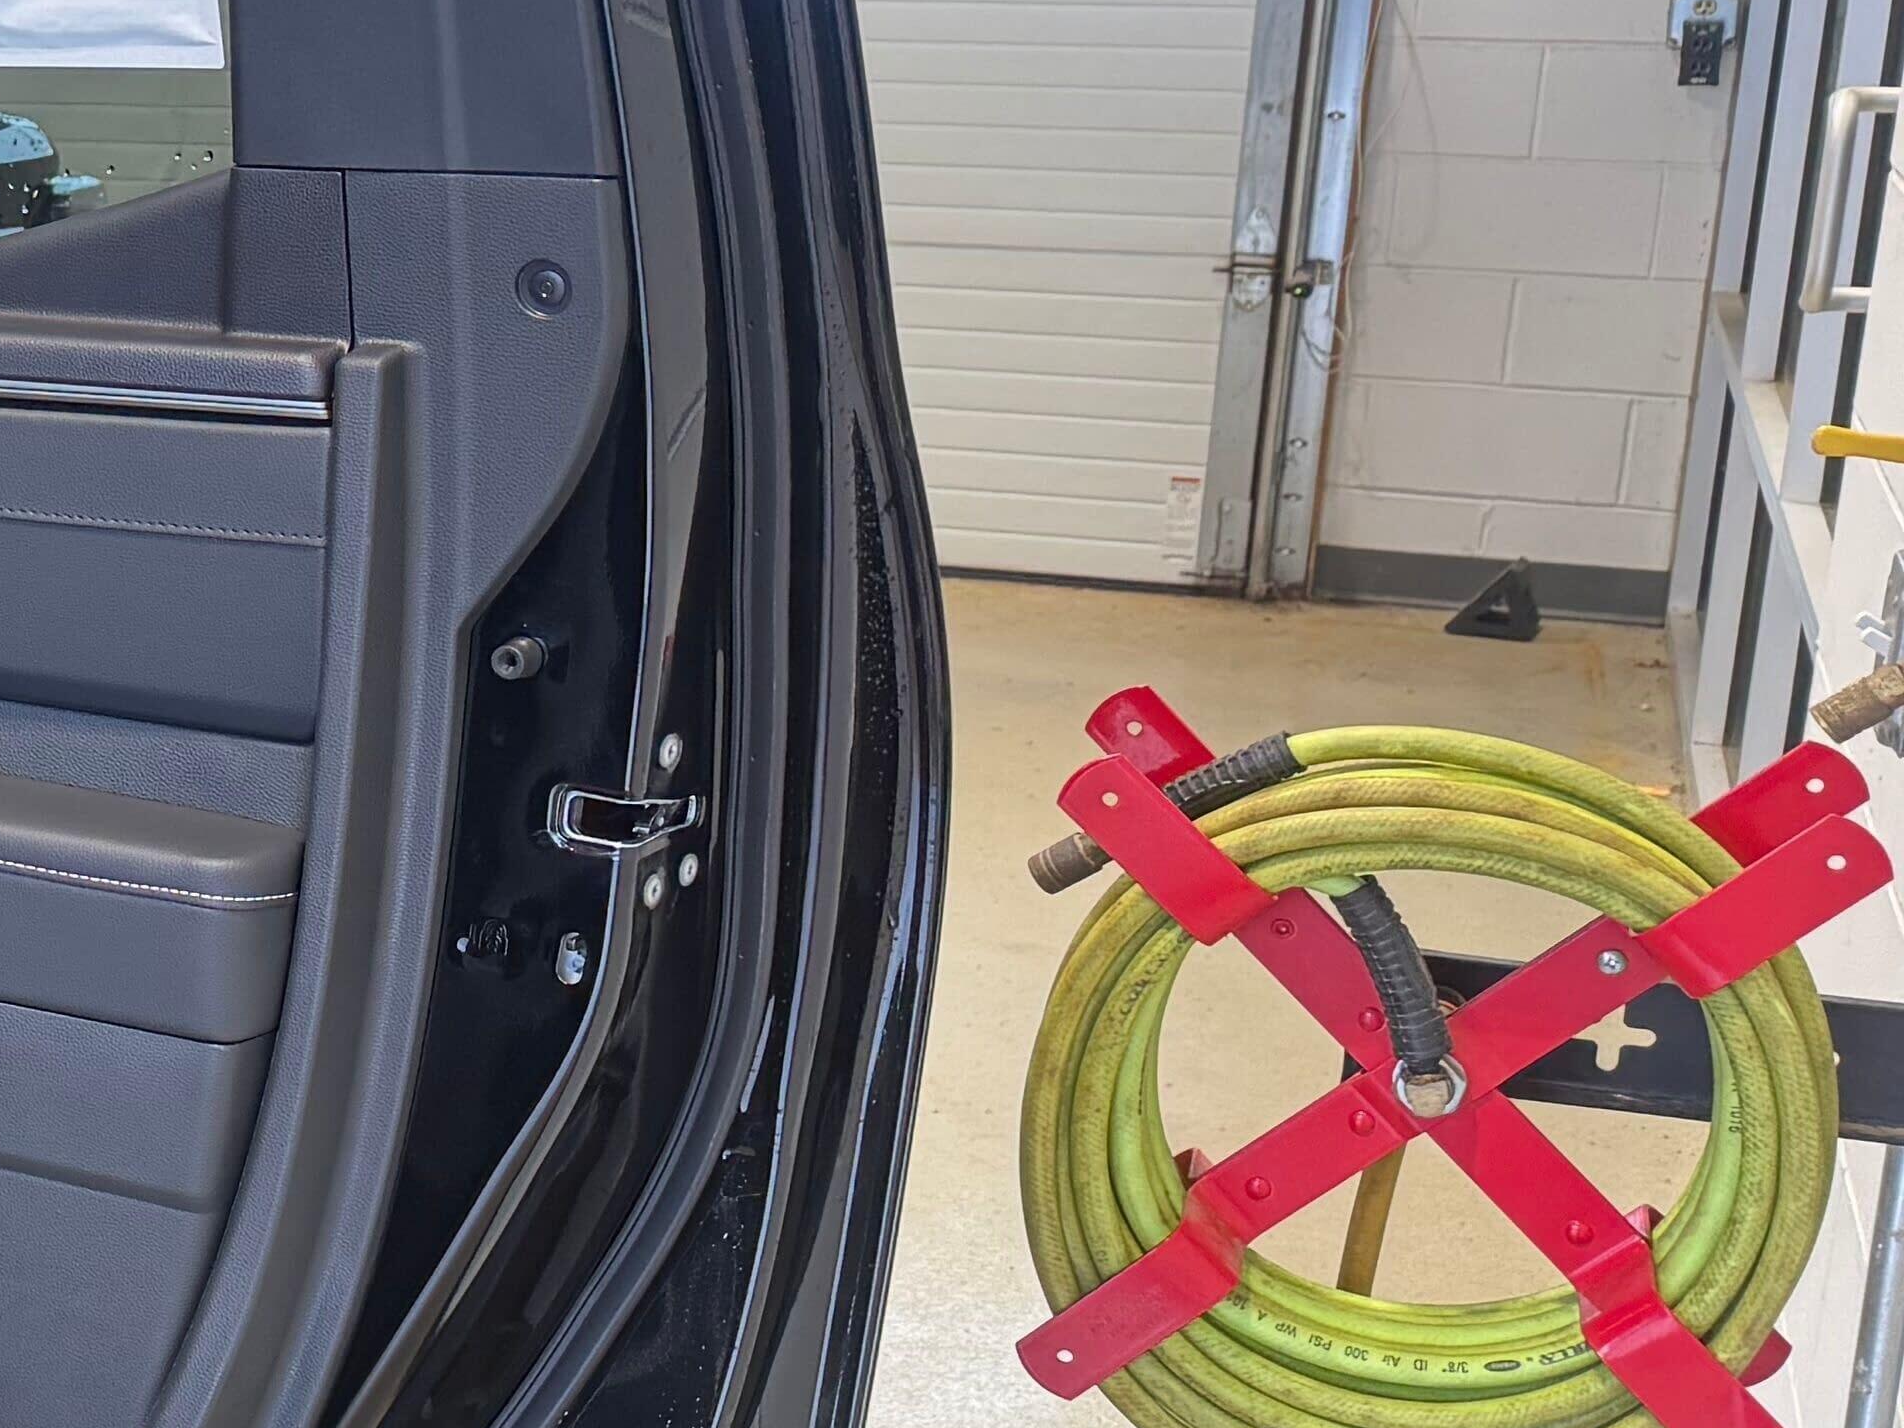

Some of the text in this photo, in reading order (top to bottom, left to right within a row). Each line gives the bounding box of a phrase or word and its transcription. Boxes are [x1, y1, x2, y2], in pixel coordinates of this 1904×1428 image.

[1275, 1322, 1297, 1338] WP
[1309, 1334, 1333, 1351] PSI
[1344, 1345, 1369, 1361] 300
[1381, 1355, 1401, 1368] Air
[1413, 1358, 1428, 1371] ID
